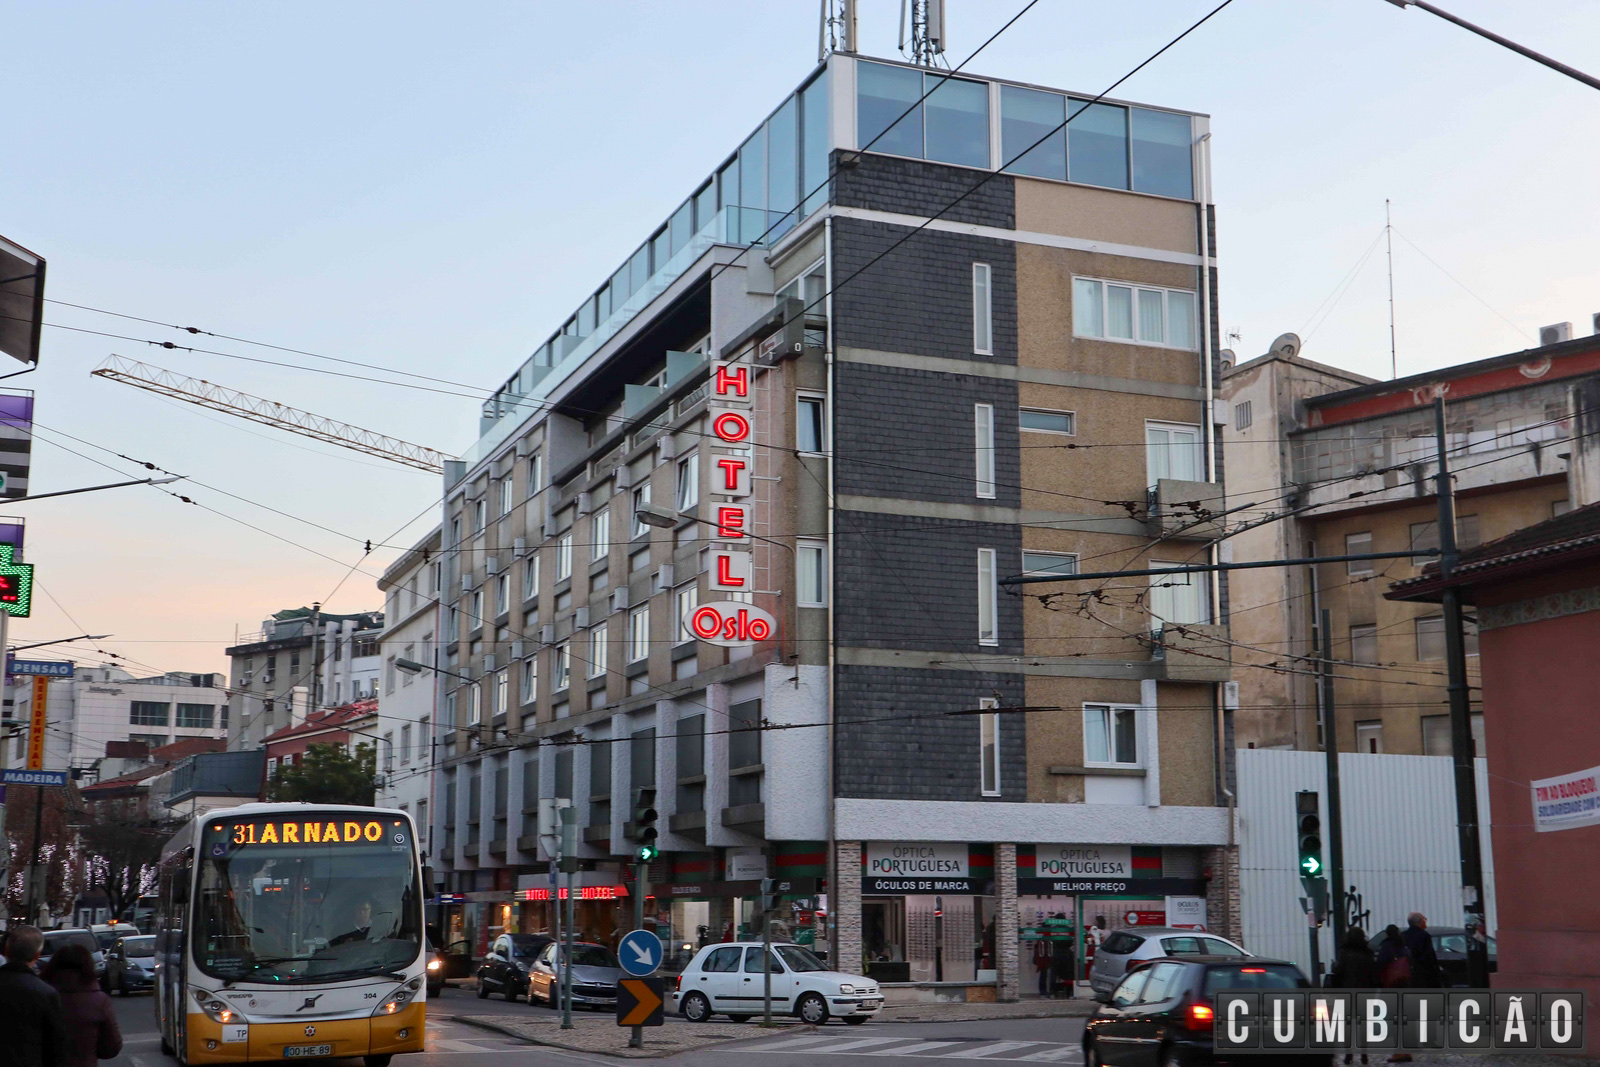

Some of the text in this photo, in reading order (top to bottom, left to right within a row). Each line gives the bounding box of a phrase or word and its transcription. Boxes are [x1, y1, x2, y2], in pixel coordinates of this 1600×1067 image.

[714, 364, 749, 587] HOTEL
[692, 606, 770, 642] Oslo
[14, 662, 69, 675] PENSÃO
[32, 677, 45, 768] RESIDENCIAL
[4, 772, 63, 785] MADEIRA
[233, 821, 383, 844] 31 ARNADO
[892, 844, 936, 858] ÓPTICA
[872, 858, 961, 875] PORTUGUESA
[1041, 860, 1124, 878] PORTUGUESA
[875, 880, 969, 890] ÓCULOS DE MARCA
[1053, 882, 1126, 893] MELHOR PREÇO
[581, 887, 613, 899] HOTEL
[236, 1029, 247, 1038] TP
